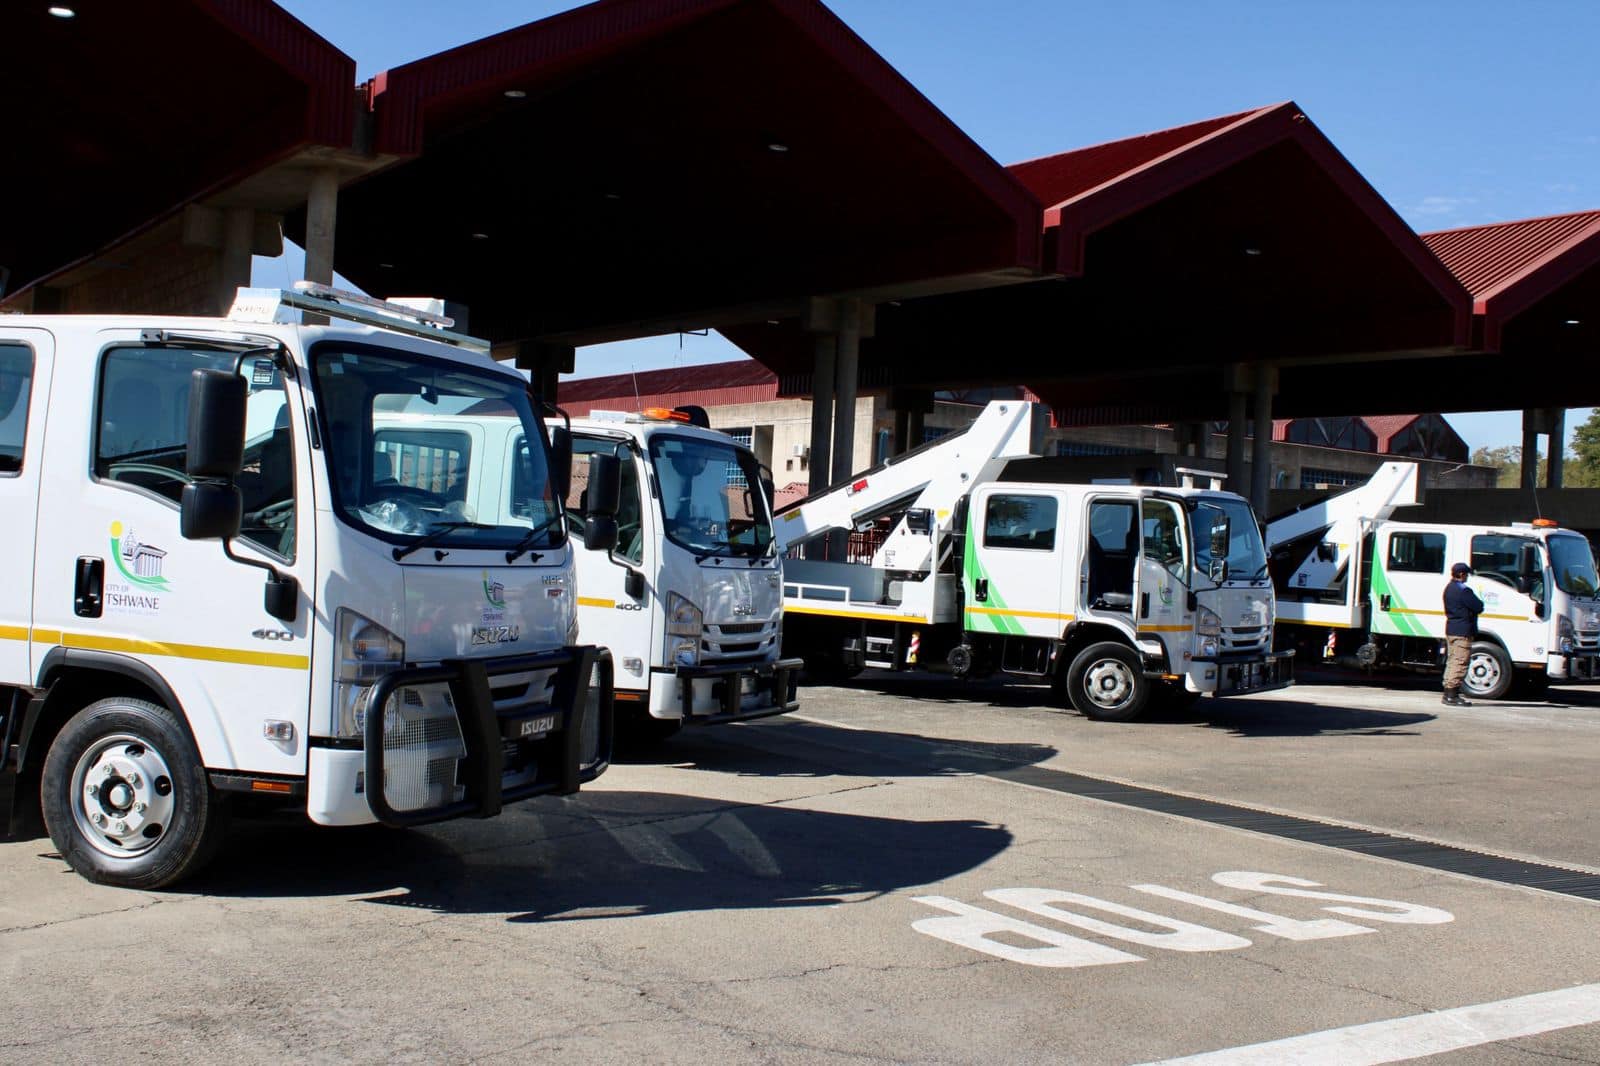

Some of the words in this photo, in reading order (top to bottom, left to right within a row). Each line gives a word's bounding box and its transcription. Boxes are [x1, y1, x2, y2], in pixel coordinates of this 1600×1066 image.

[105, 584, 119, 592] CITY
[105, 593, 160, 610] TSHWANE
[251, 628, 294, 641] 400
[472, 626, 520, 645] ISUZU
[520, 716, 554, 736] ISUZU
[911, 871, 1455, 967] STOP
